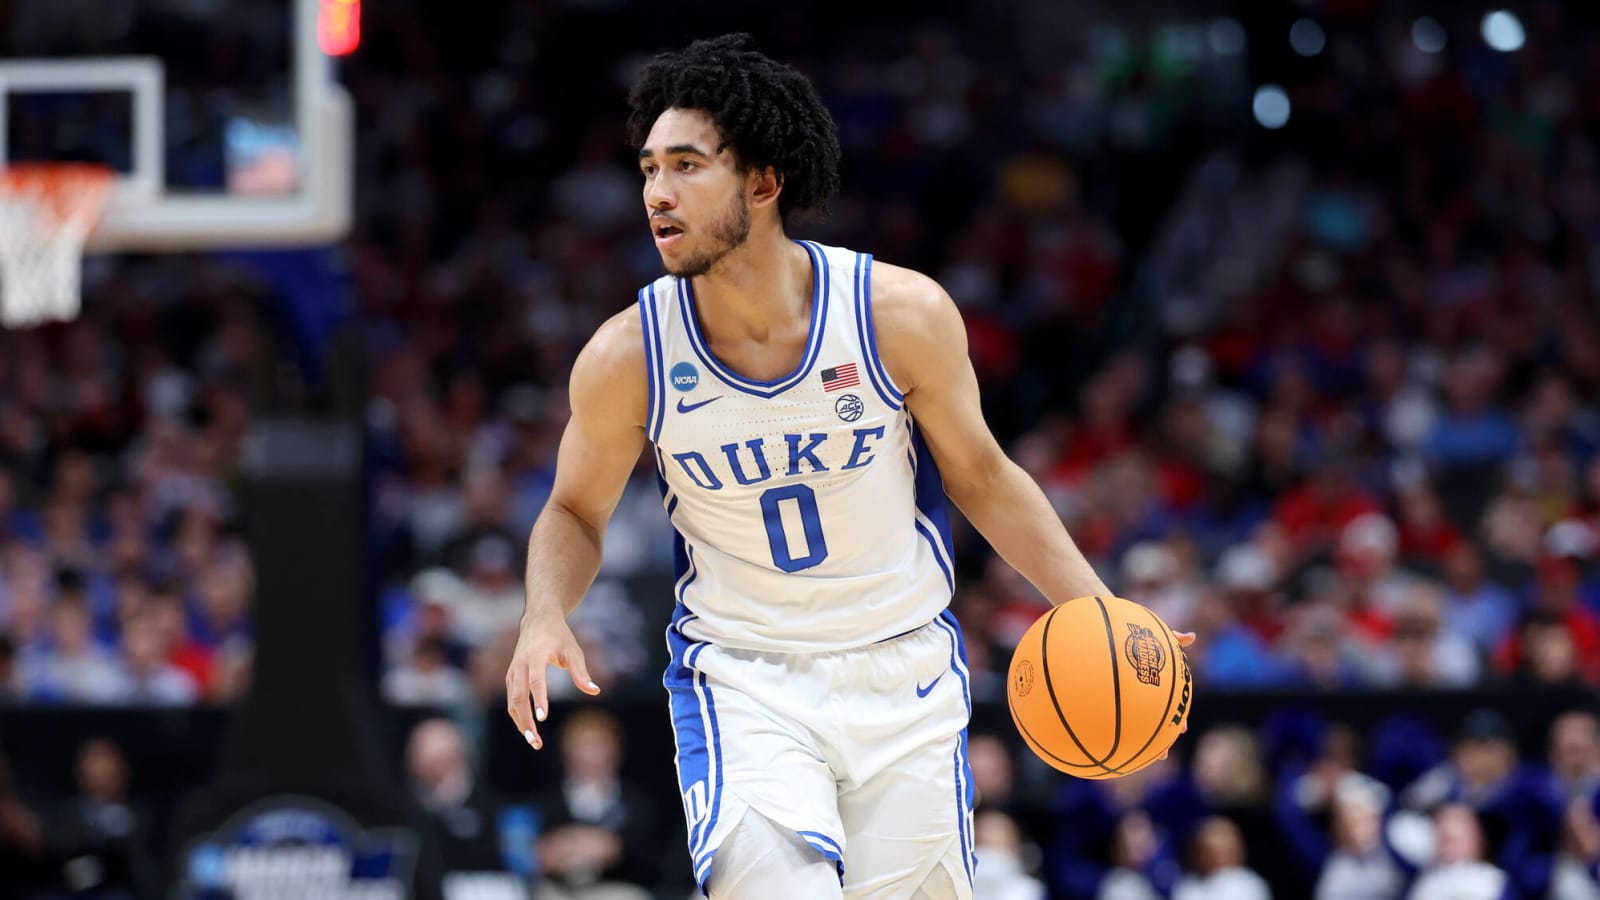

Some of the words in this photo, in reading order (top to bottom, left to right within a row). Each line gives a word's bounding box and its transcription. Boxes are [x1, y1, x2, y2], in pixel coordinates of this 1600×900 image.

[674, 375, 697, 384] NCAA
[840, 401, 861, 411] ACC
[671, 425, 885, 490] DUKE
[759, 483, 828, 573] 0
[1137, 639, 1150, 684] MADNESS
[1147, 637, 1158, 669] MARCH
